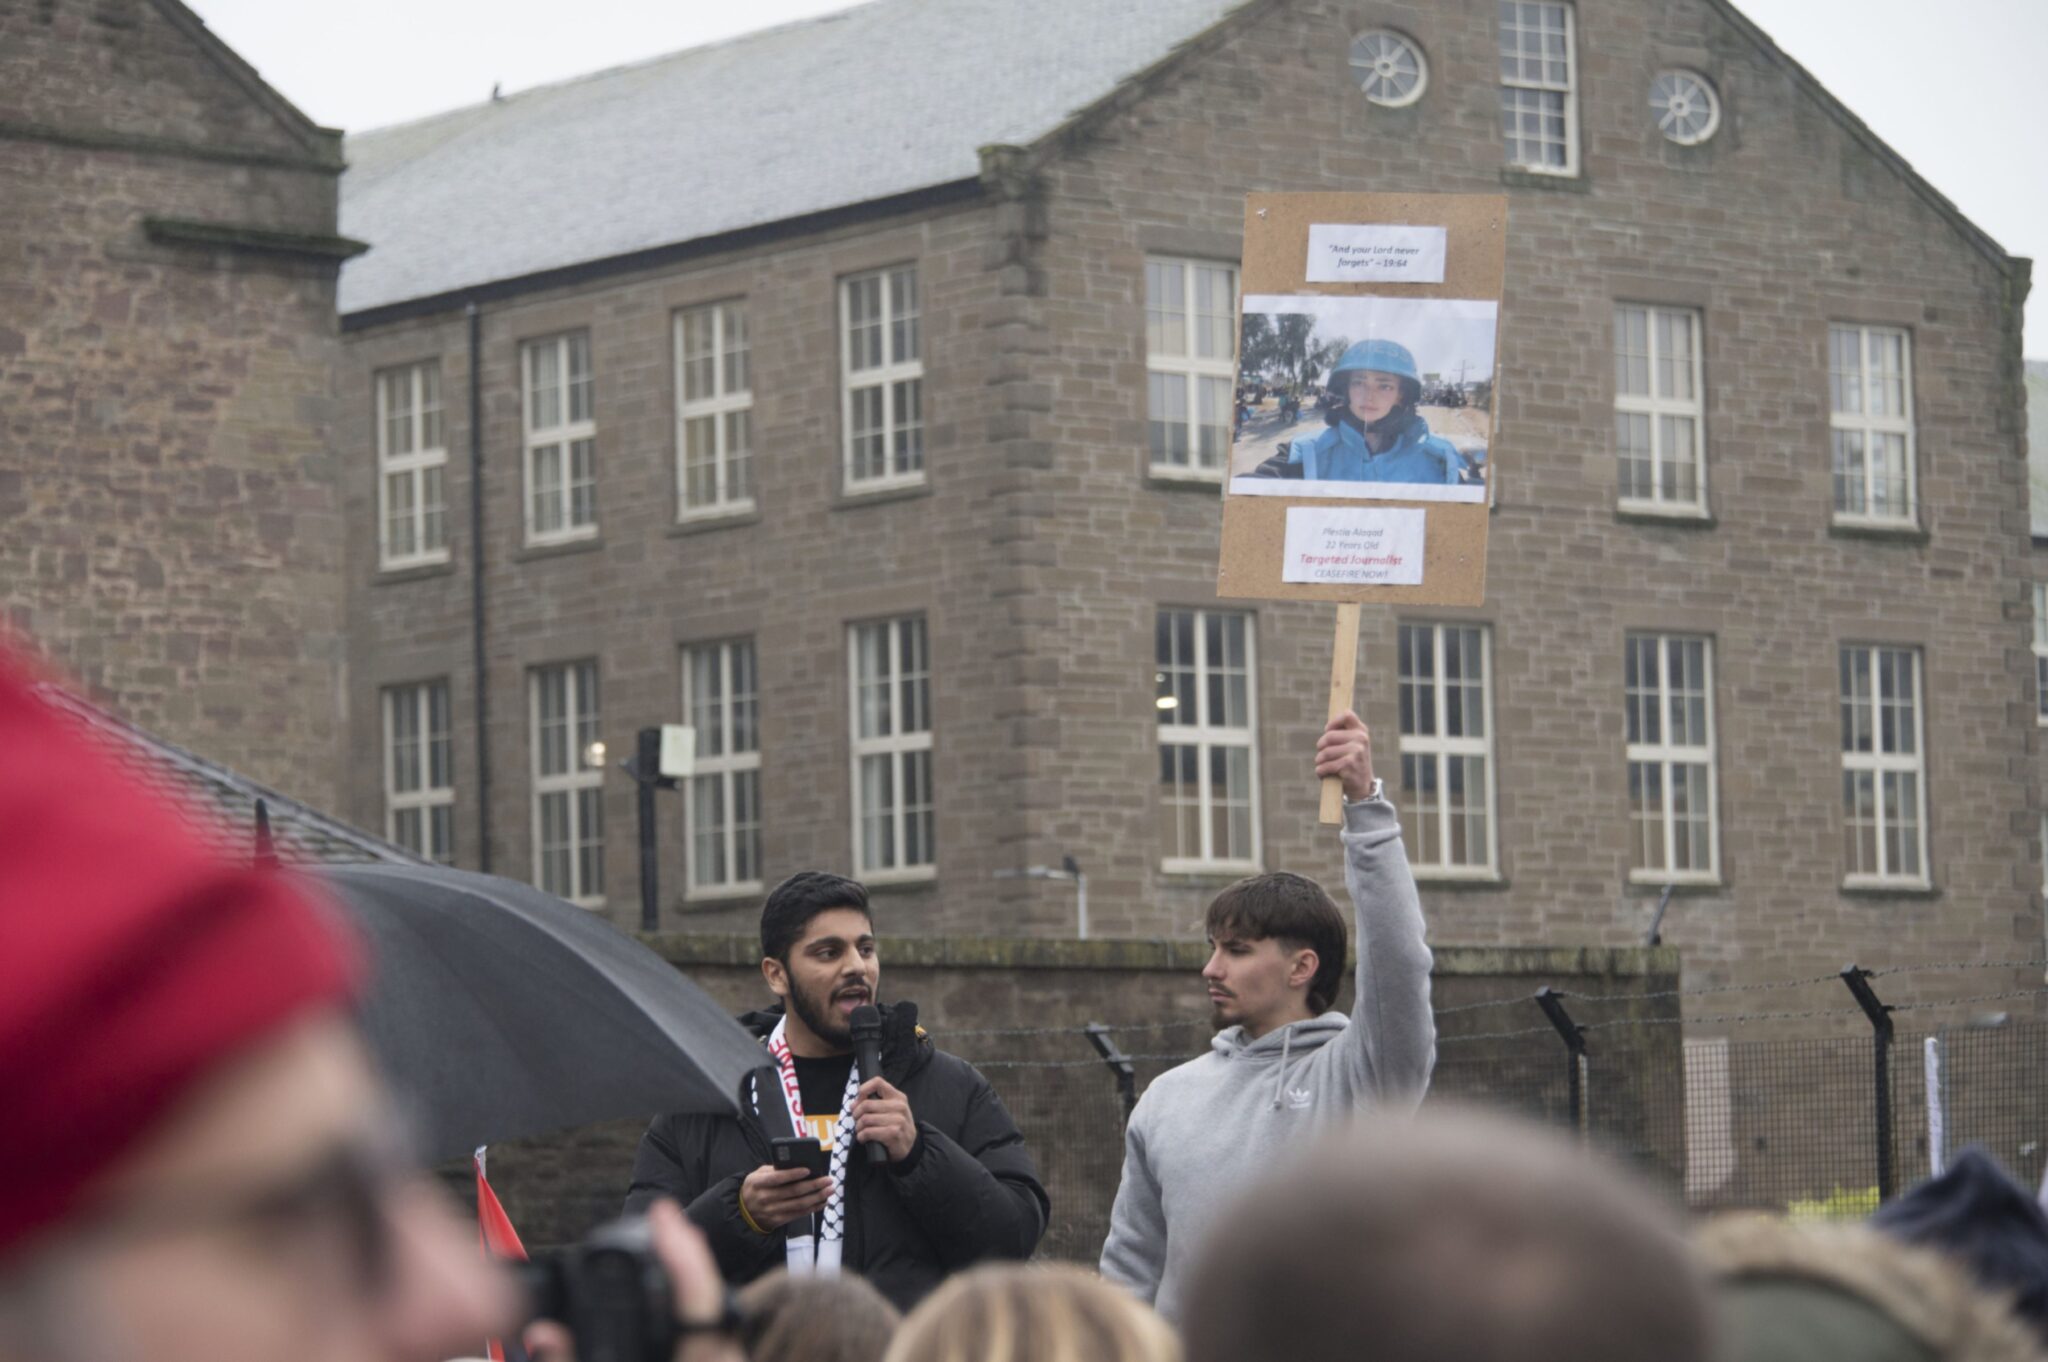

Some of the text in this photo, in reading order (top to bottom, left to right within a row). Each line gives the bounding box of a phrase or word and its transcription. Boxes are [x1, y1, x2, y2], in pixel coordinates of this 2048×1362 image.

[1352, 246, 1372, 255] your
[1373, 245, 1393, 255] Lord
[1383, 258, 1408, 268] 19:64
[1325, 541, 1379, 550] 22 Years Old
[1300, 553, 1403, 566] Targeted Journalist
[1314, 569, 1361, 578] CEASEFIRE
